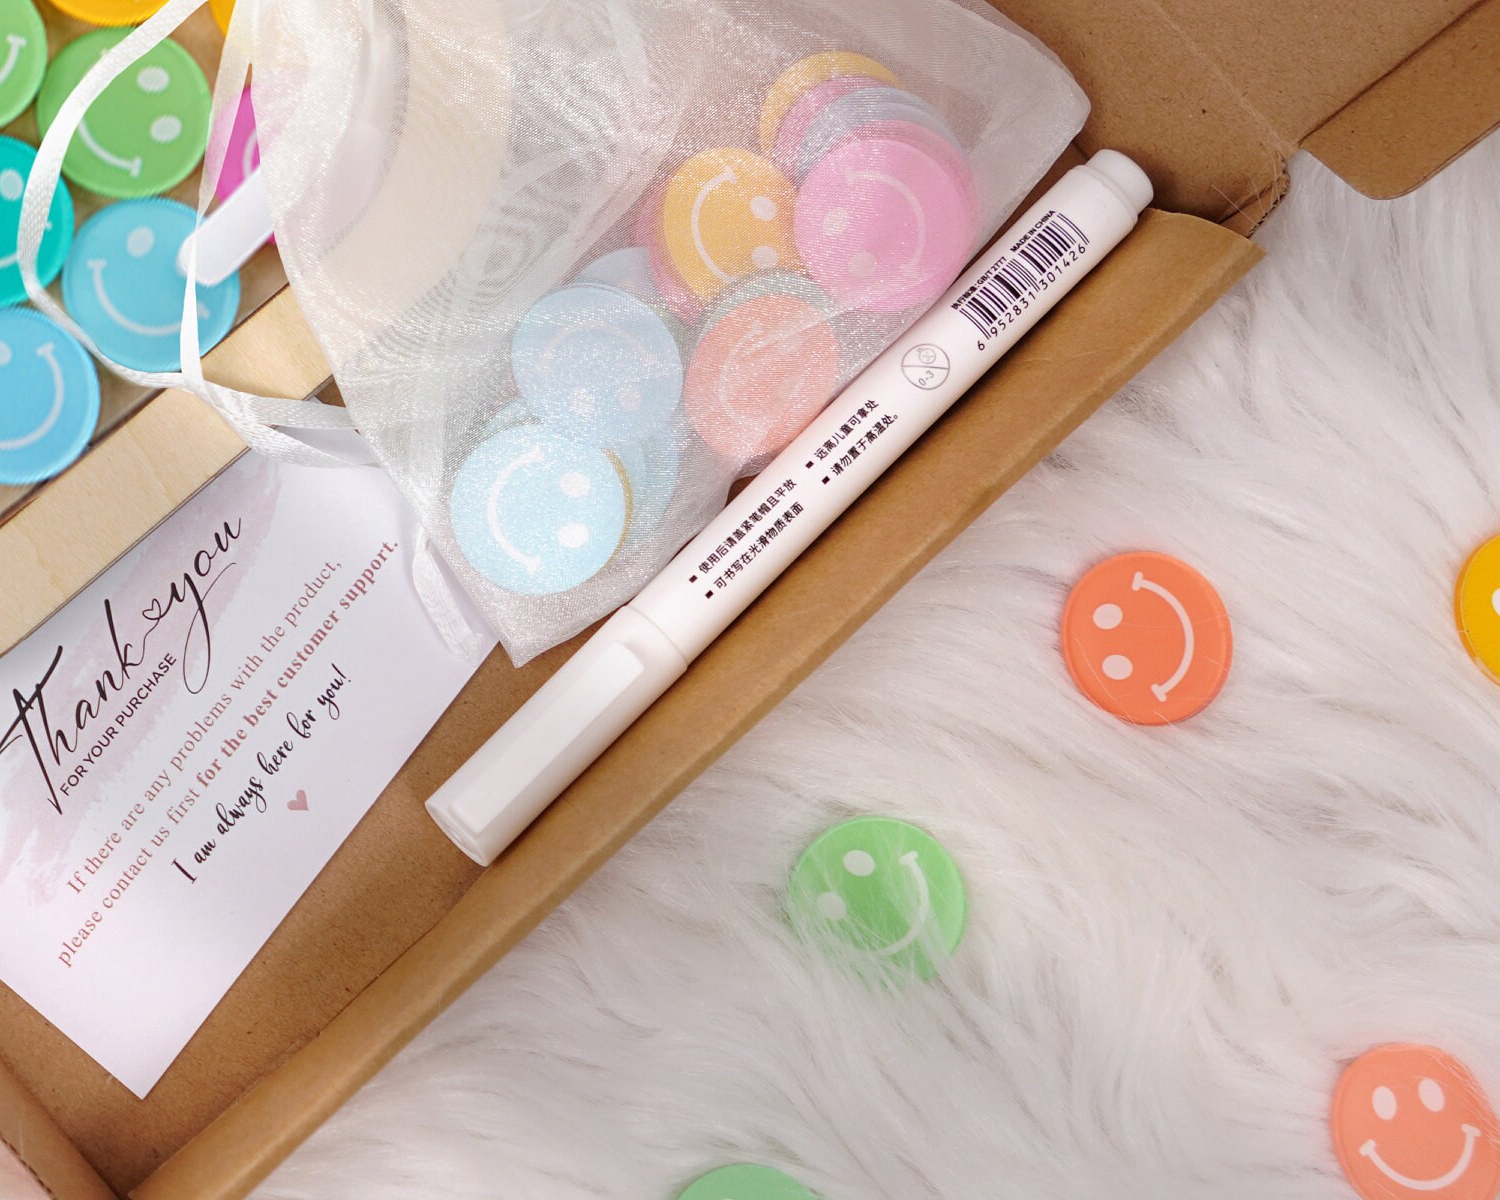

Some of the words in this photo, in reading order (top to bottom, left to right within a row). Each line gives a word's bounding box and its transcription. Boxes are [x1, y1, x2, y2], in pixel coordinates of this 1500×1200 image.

[1010, 234, 1031, 253] MADE
[1028, 228, 1038, 238] IN
[1034, 210, 1056, 229] CHINA
[813, 399, 879, 461] 远离儿童可拿处
[918, 370, 935, 386] 0-3
[164, 517, 242, 695] you
[57, 910, 103, 968] please
[102, 847, 153, 909] contact
[150, 825, 170, 848] us
[166, 787, 200, 825] first
[195, 757, 223, 788] for
[219, 727, 248, 758] the
[242, 688, 278, 728] best
[276, 609, 340, 689] customer
[338, 540, 399, 610] support.
[59, 764, 89, 797] FOR
[81, 726, 120, 770] YOUR
[116, 652, 178, 729] PURCHASE
[66, 870, 87, 895] If
[84, 832, 122, 876] there
[120, 802, 145, 831] are
[144, 769, 172, 802] any
[169, 693, 233, 772] problems
[230, 653, 264, 691] with
[260, 625, 286, 653] the
[284, 559, 342, 628] product,
[171, 857, 198, 885] I
[193, 837, 217, 864] am
[215, 776, 268, 836] always
[256, 738, 294, 775] here
[286, 709, 317, 739] for
[316, 662, 352, 721] you!
